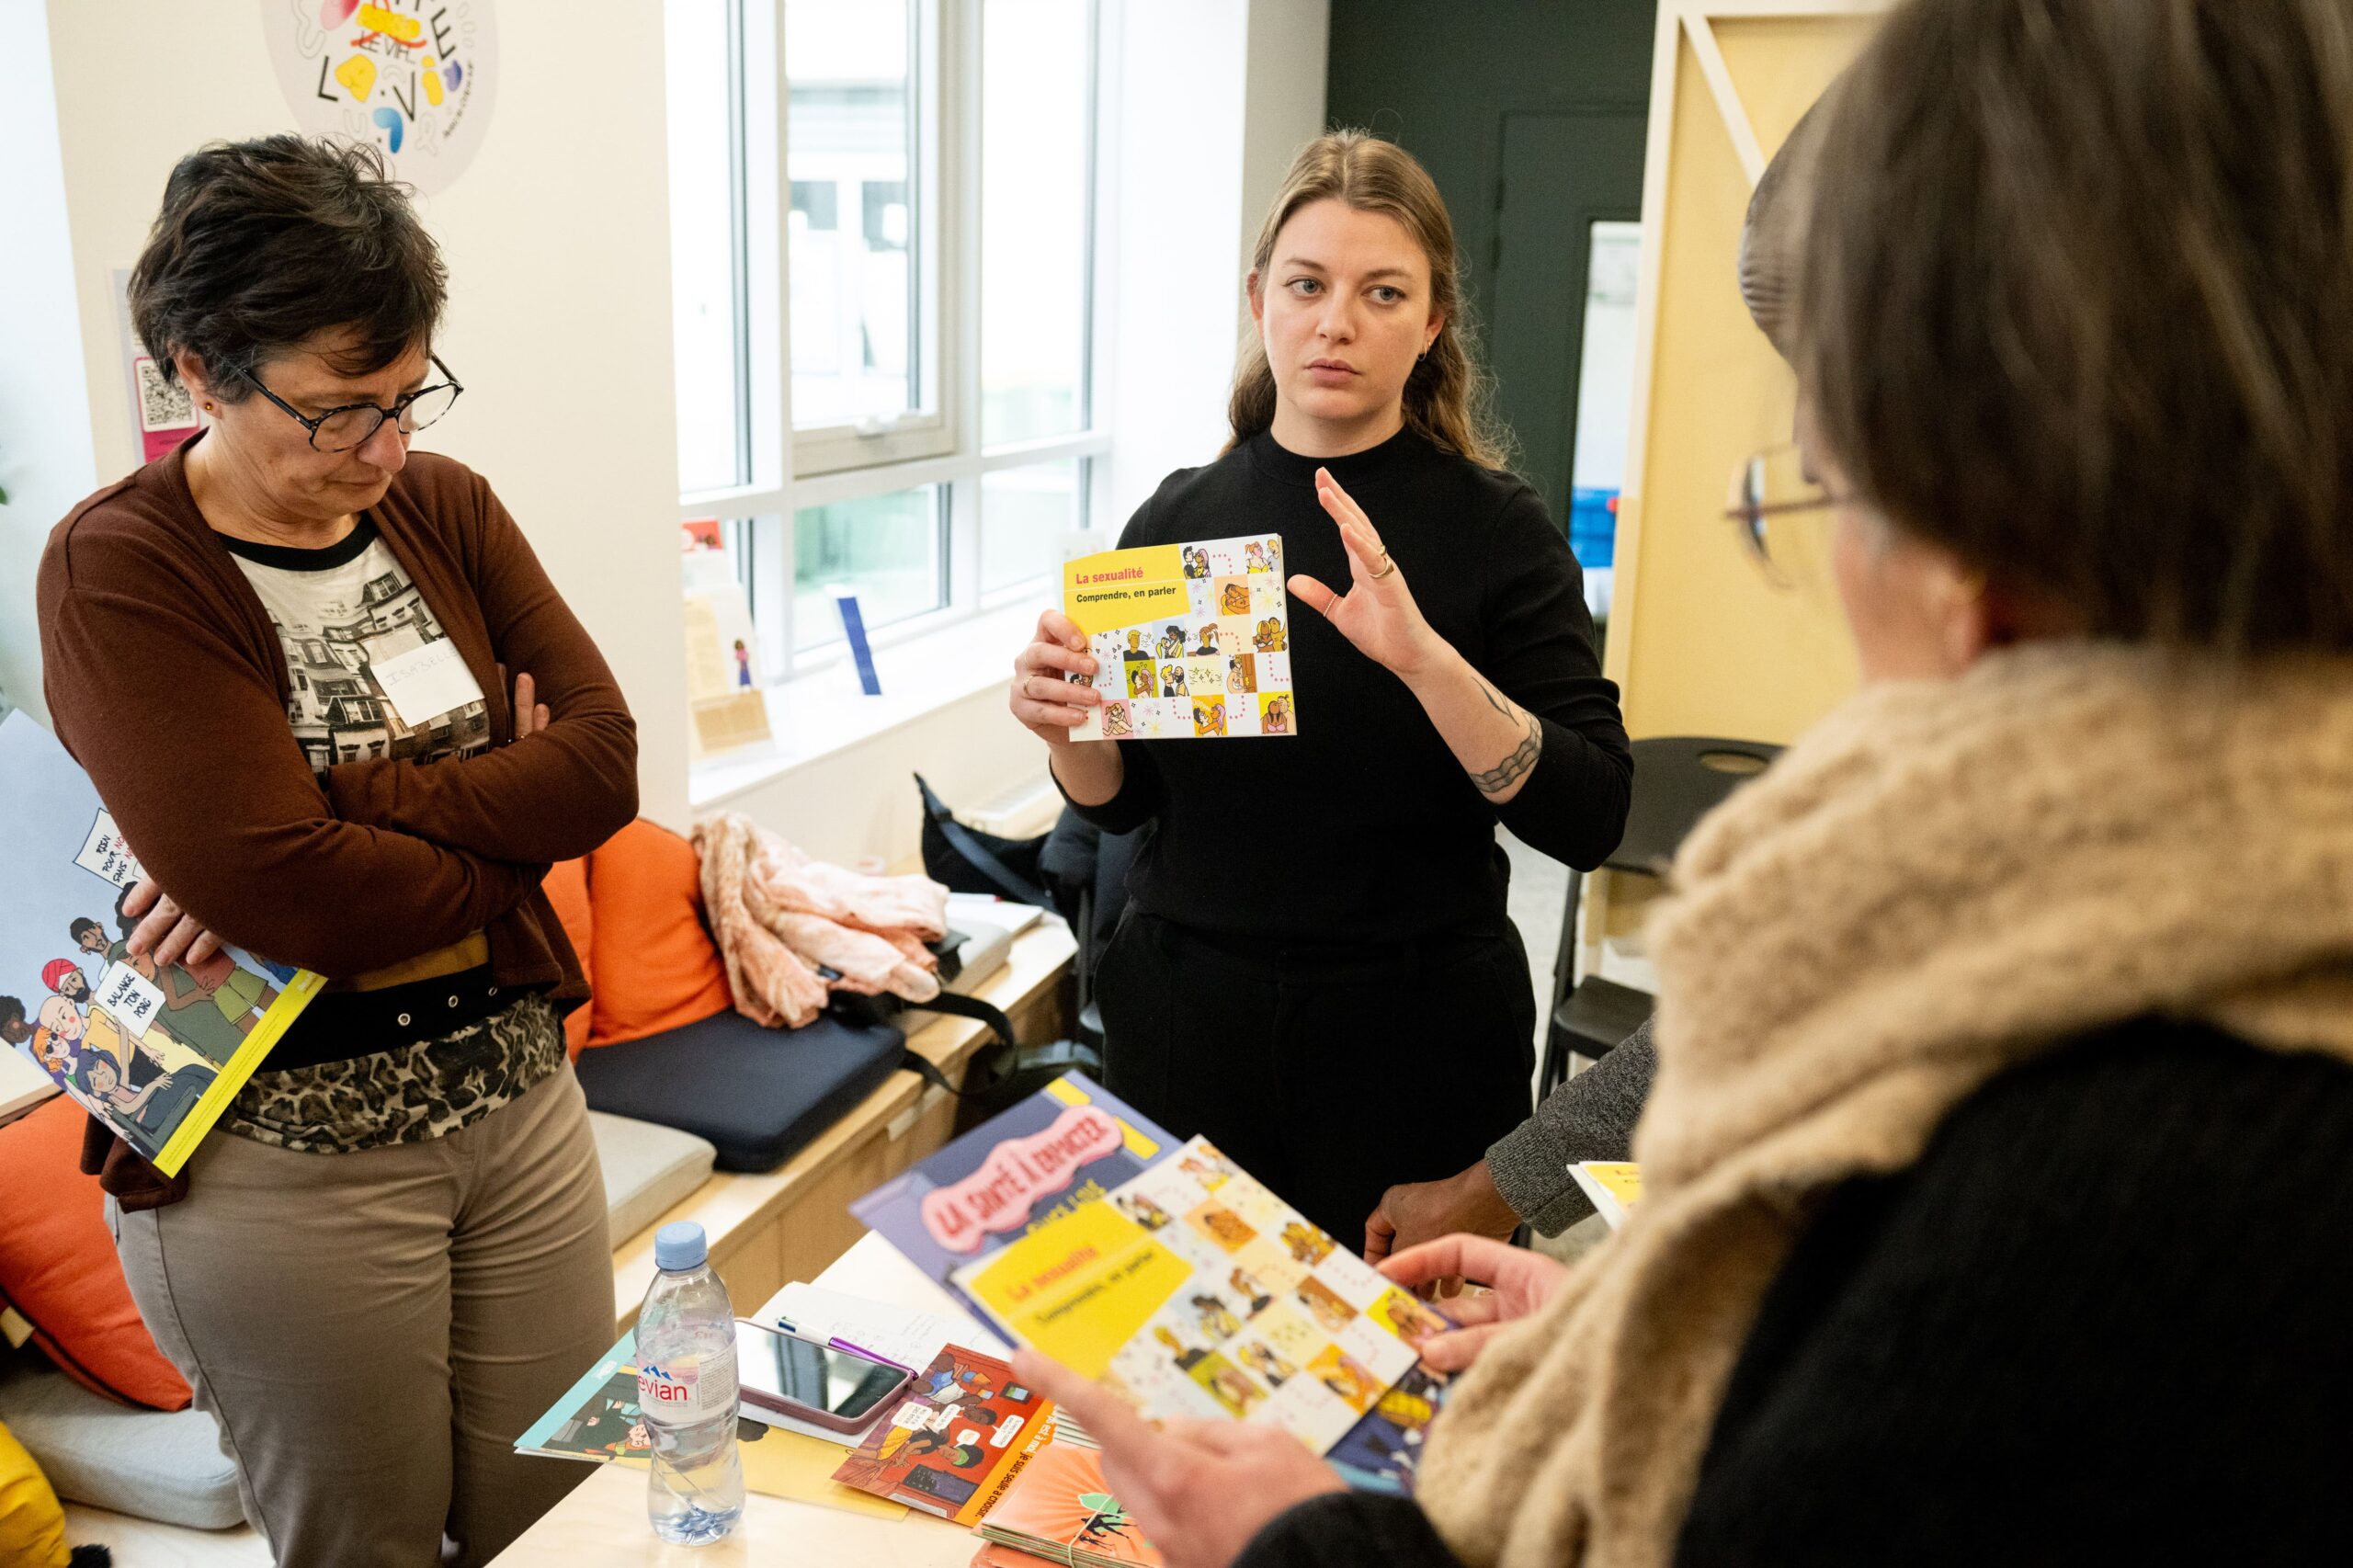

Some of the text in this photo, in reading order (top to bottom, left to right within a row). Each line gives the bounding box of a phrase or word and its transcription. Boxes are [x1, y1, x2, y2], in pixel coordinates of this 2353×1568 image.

[1075, 567, 1143, 585] La sexualité
[1076, 586, 1176, 603] Comprendre, en parler
[102, 850, 121, 872] POUR
[112, 860, 128, 882] SANS
[107, 972, 135, 1007] BALANCE
[123, 989, 141, 1007] TON
[133, 997, 152, 1018] PORC
[638, 1375, 688, 1401] evian
[1018, 1451, 1032, 1461] je
[1009, 1460, 1025, 1474] suis
